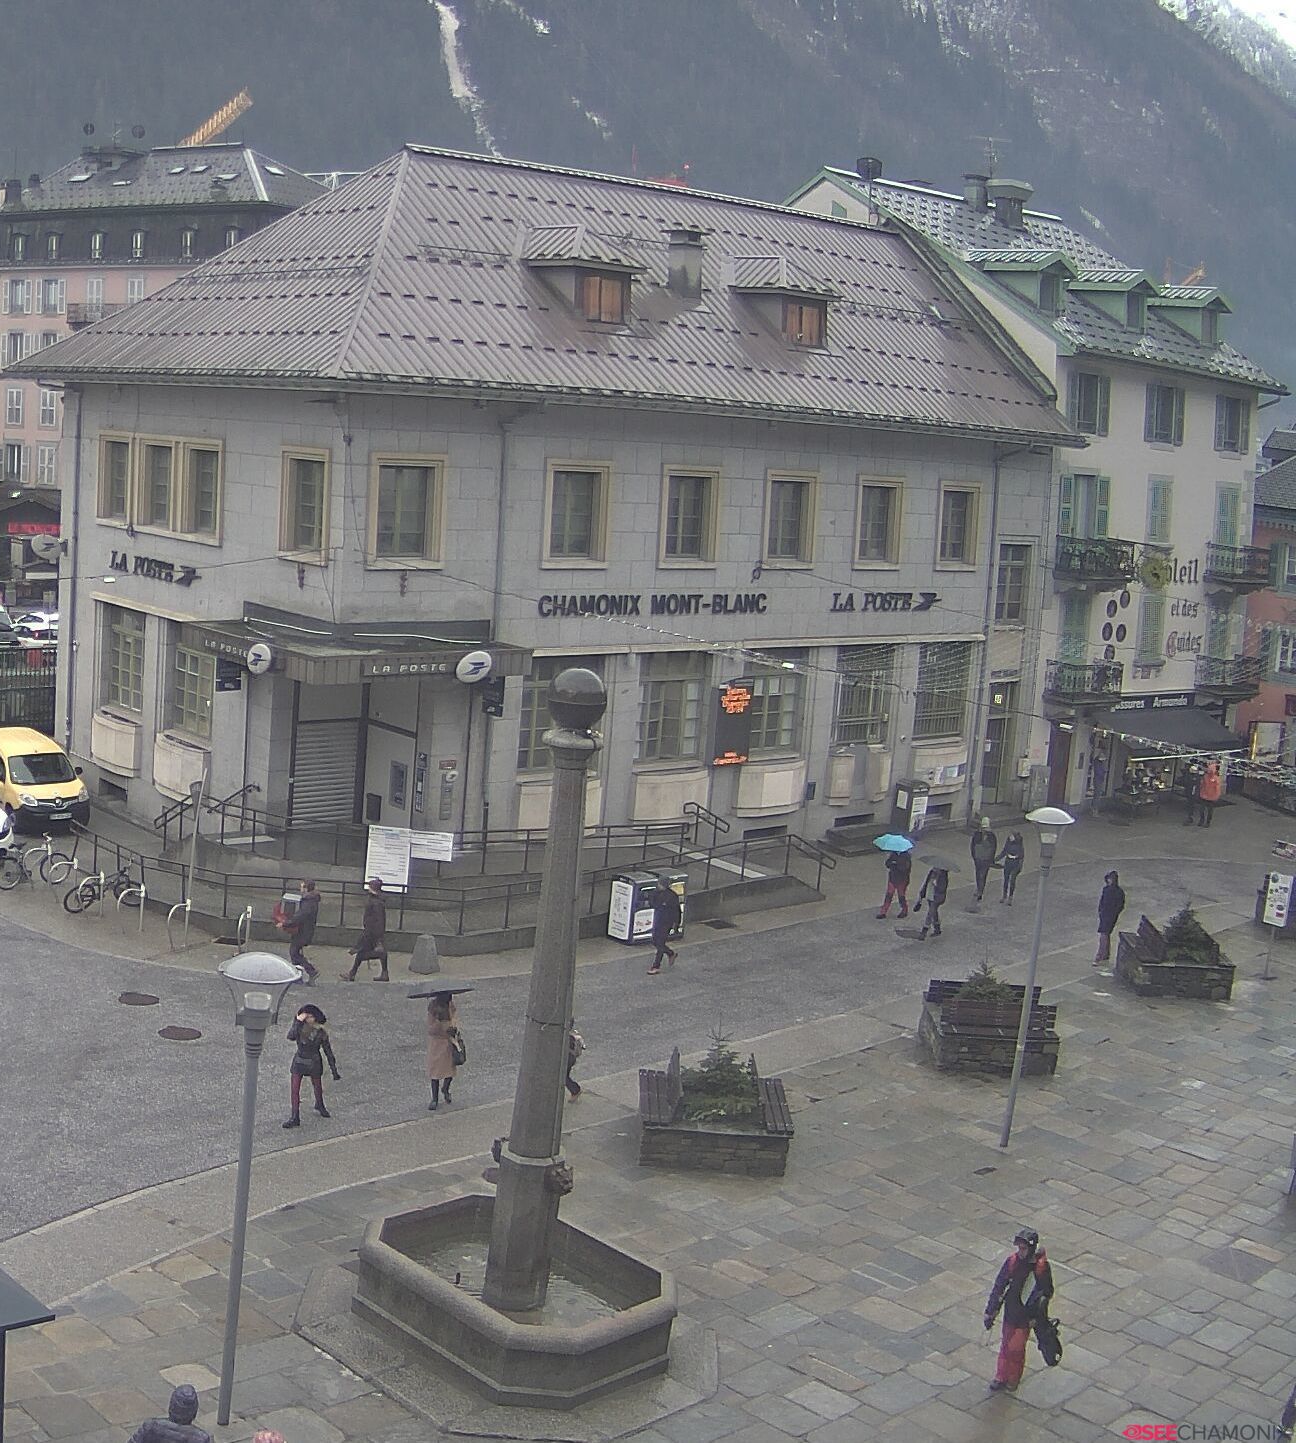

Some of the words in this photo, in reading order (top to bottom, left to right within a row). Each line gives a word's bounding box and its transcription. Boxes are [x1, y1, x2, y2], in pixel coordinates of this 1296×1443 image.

[109, 550, 129, 573] LA
[133, 556, 175, 583] POSTE
[1163, 557, 1199, 584] oleil
[537, 594, 642, 618] CHAMONIX
[650, 593, 768, 616] MONT-BLANC
[830, 592, 856, 612] LA
[861, 592, 913, 612] POSTE
[204, 639, 217, 649] LA
[372, 664, 391, 674] LA
[399, 663, 447, 673] POSTE
